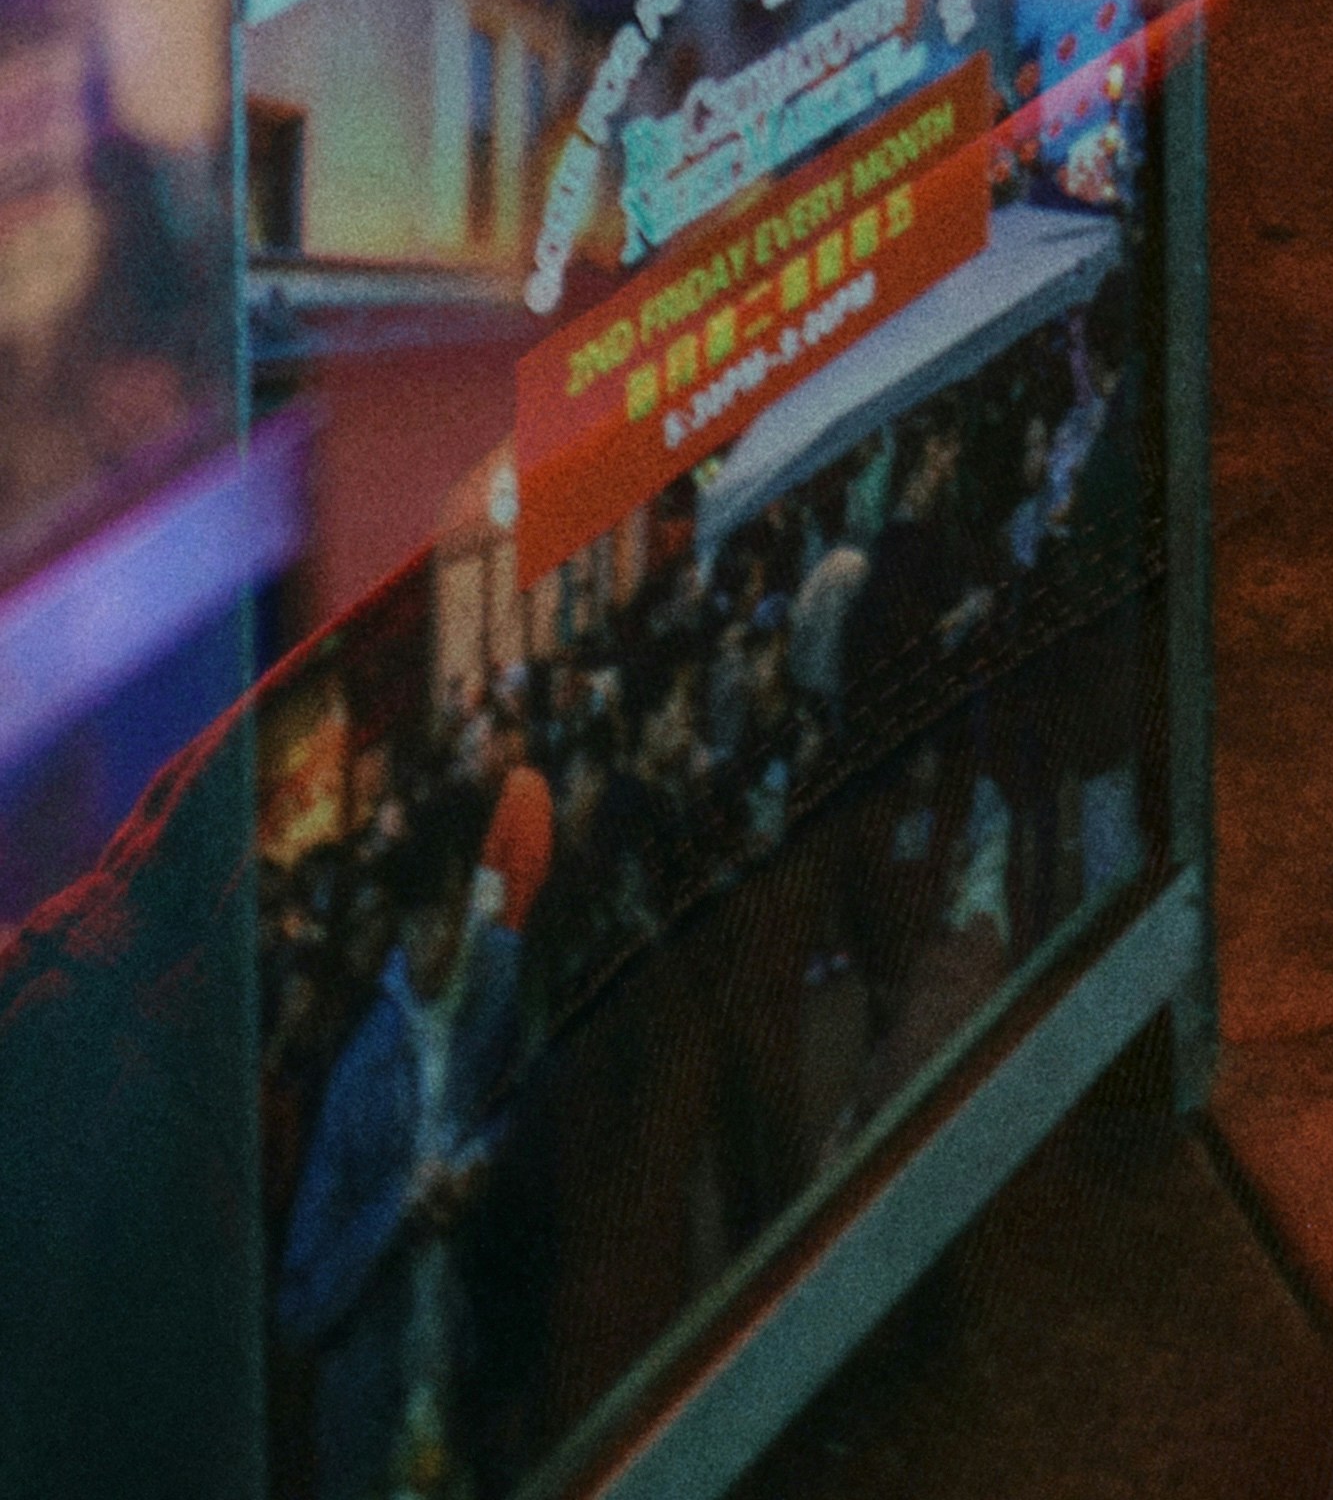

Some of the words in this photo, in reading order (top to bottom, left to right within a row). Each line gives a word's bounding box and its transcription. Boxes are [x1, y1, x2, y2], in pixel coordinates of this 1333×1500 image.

[639, 238, 750, 345] FRIDAY
[753, 173, 845, 264] EVERY
[850, 99, 955, 197] MONTH
